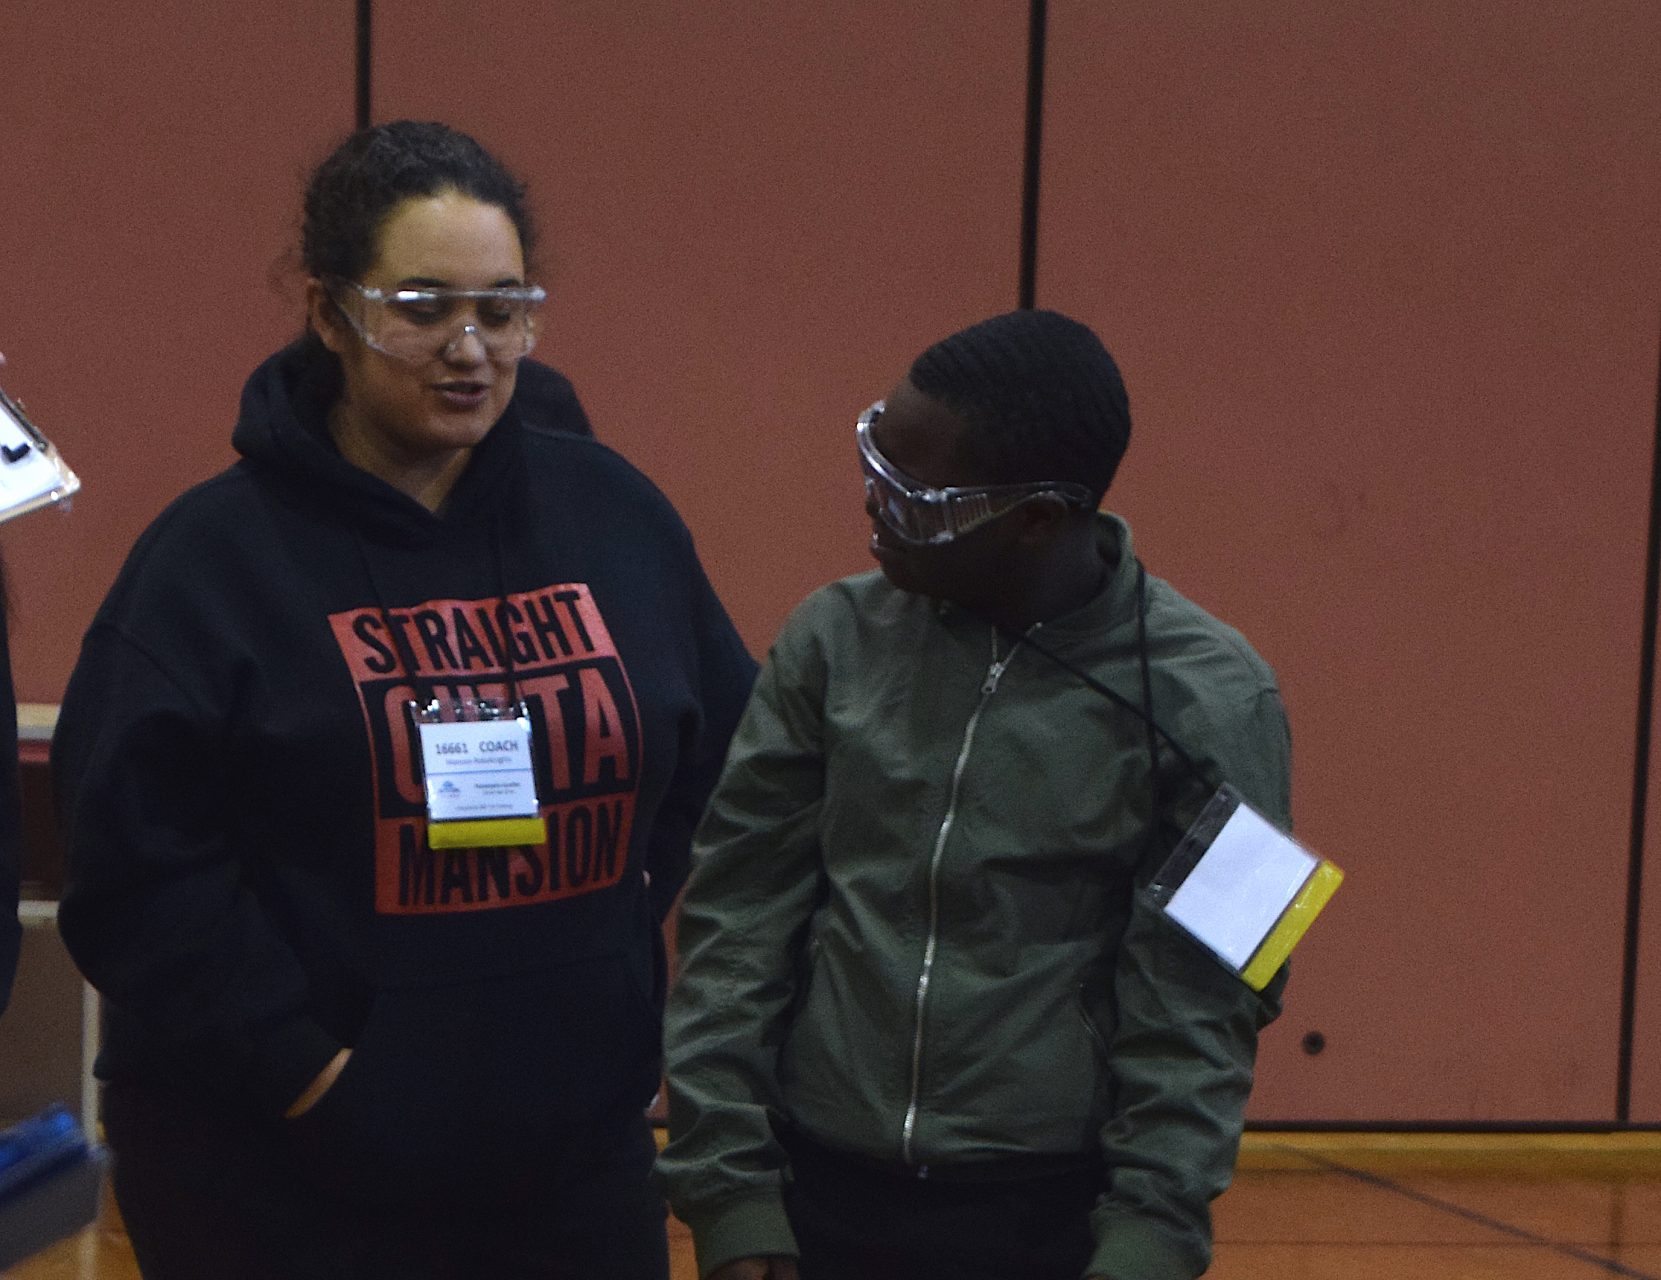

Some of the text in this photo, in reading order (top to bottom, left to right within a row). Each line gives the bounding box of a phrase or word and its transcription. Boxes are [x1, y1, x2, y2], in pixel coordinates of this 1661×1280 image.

[352, 590, 595, 674] STRAIGHT
[384, 667, 631, 805] OTA
[436, 740, 519, 755] 16661 COACH
